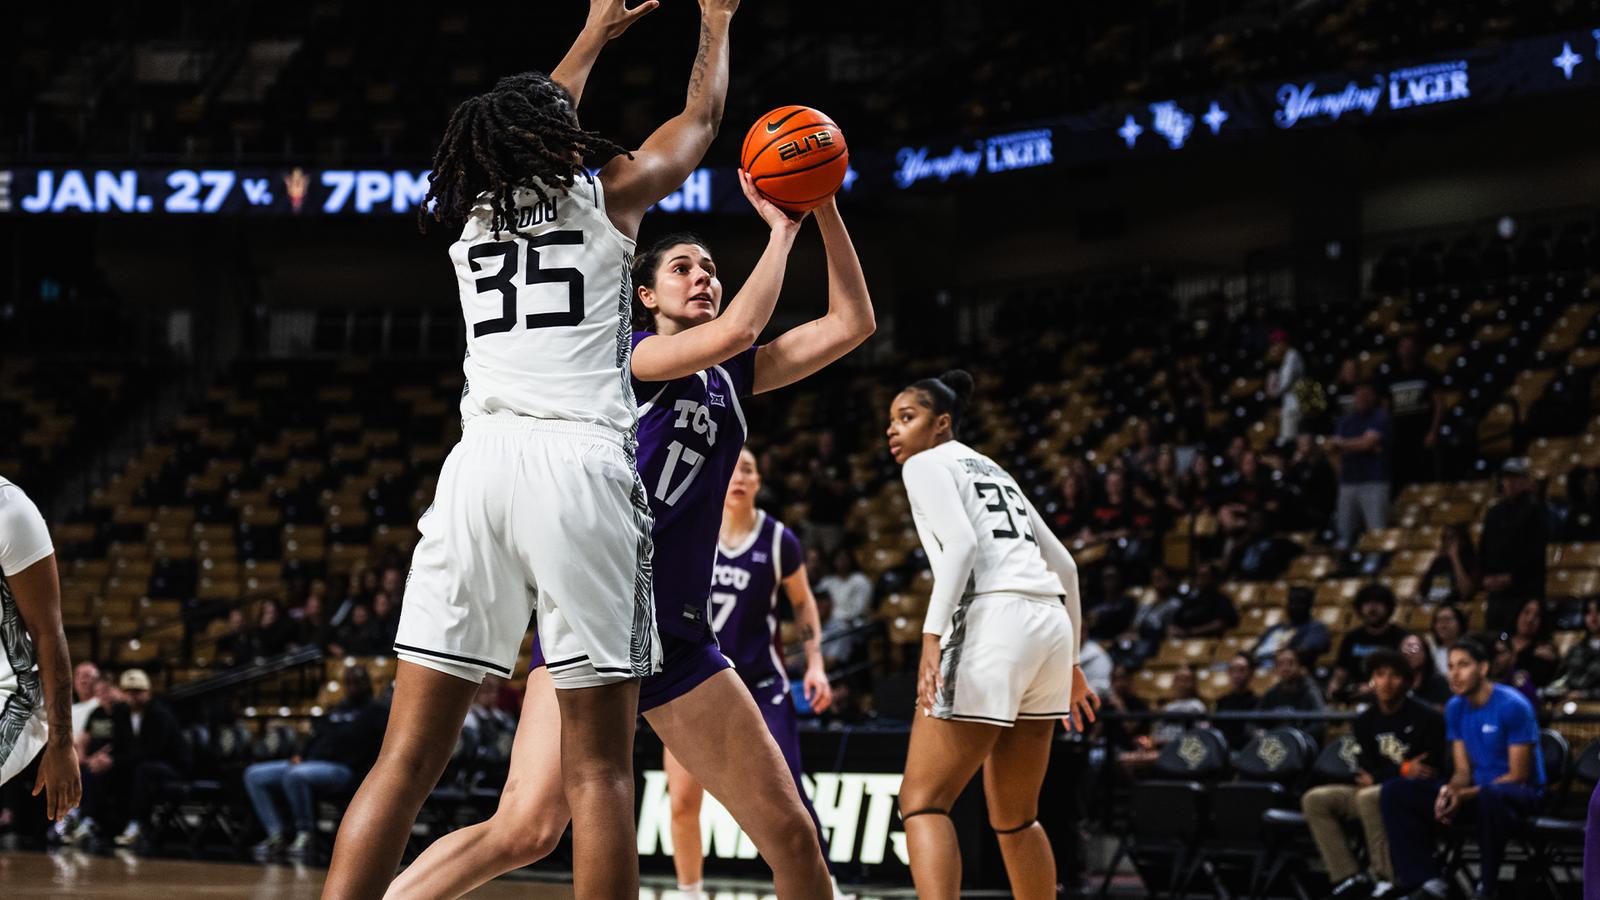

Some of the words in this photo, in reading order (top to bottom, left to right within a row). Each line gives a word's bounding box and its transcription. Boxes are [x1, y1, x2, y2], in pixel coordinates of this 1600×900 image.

[1389, 70, 1470, 110] LAGER
[778, 130, 834, 161] ELITE
[22, 170, 153, 213] JAN.
[165, 170, 235, 213] 27
[321, 170, 437, 213] 7PM
[468, 230, 585, 338] 35
[654, 440, 705, 507] 17
[711, 592, 737, 632] 7
